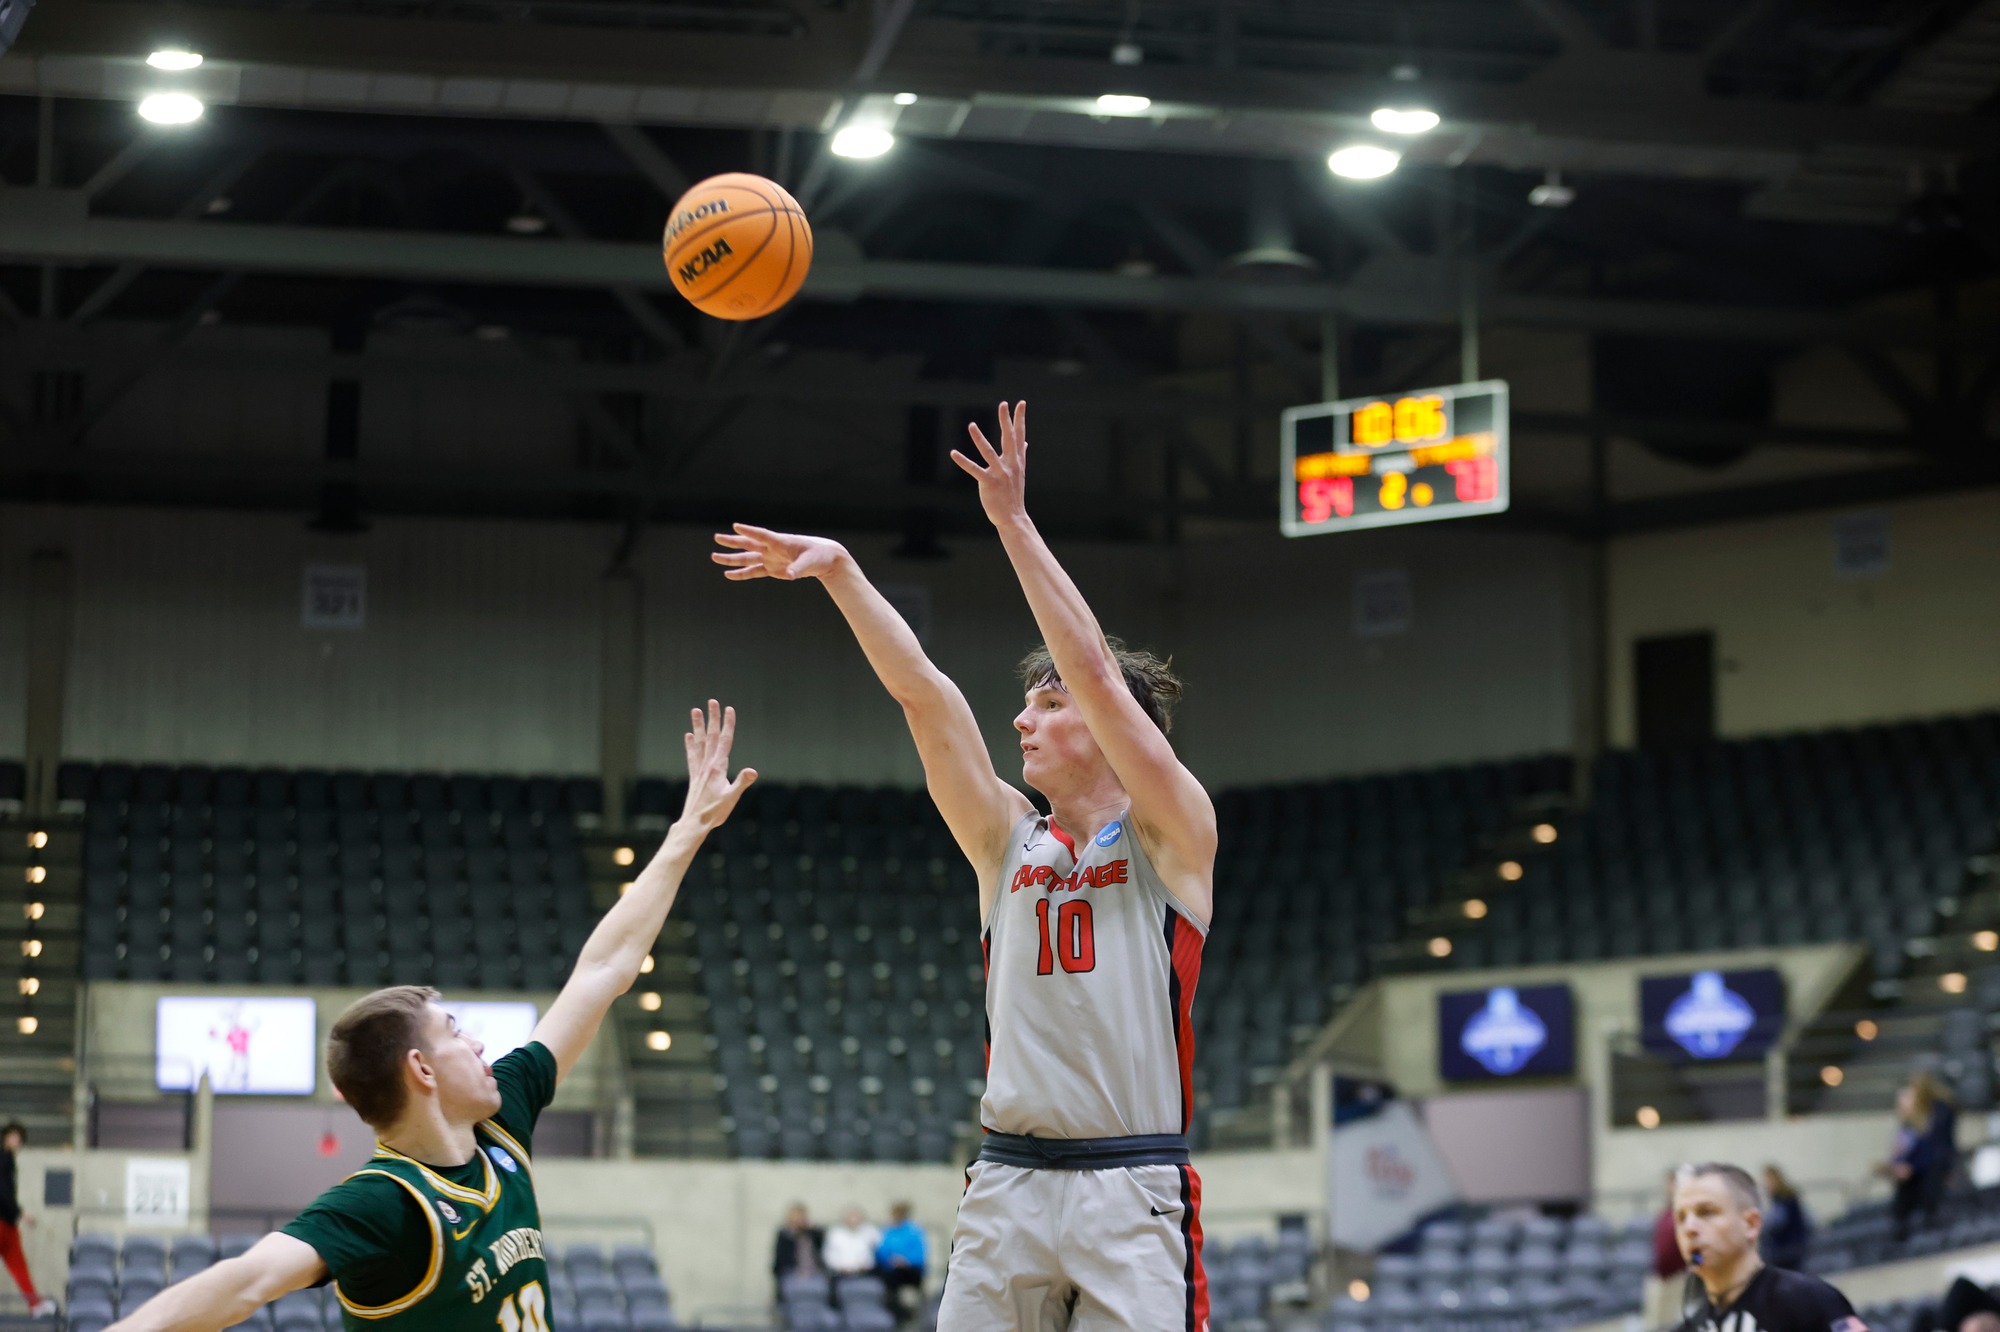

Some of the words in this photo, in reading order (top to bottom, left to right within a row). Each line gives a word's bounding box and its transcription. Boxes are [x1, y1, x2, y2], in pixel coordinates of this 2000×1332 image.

[679, 238, 733, 285] NCAA
[1099, 827, 1120, 843] NCAA
[1010, 859, 1129, 894] CARTHAGE
[1036, 898, 1095, 976] 10
[465, 1257, 498, 1304] ST.
